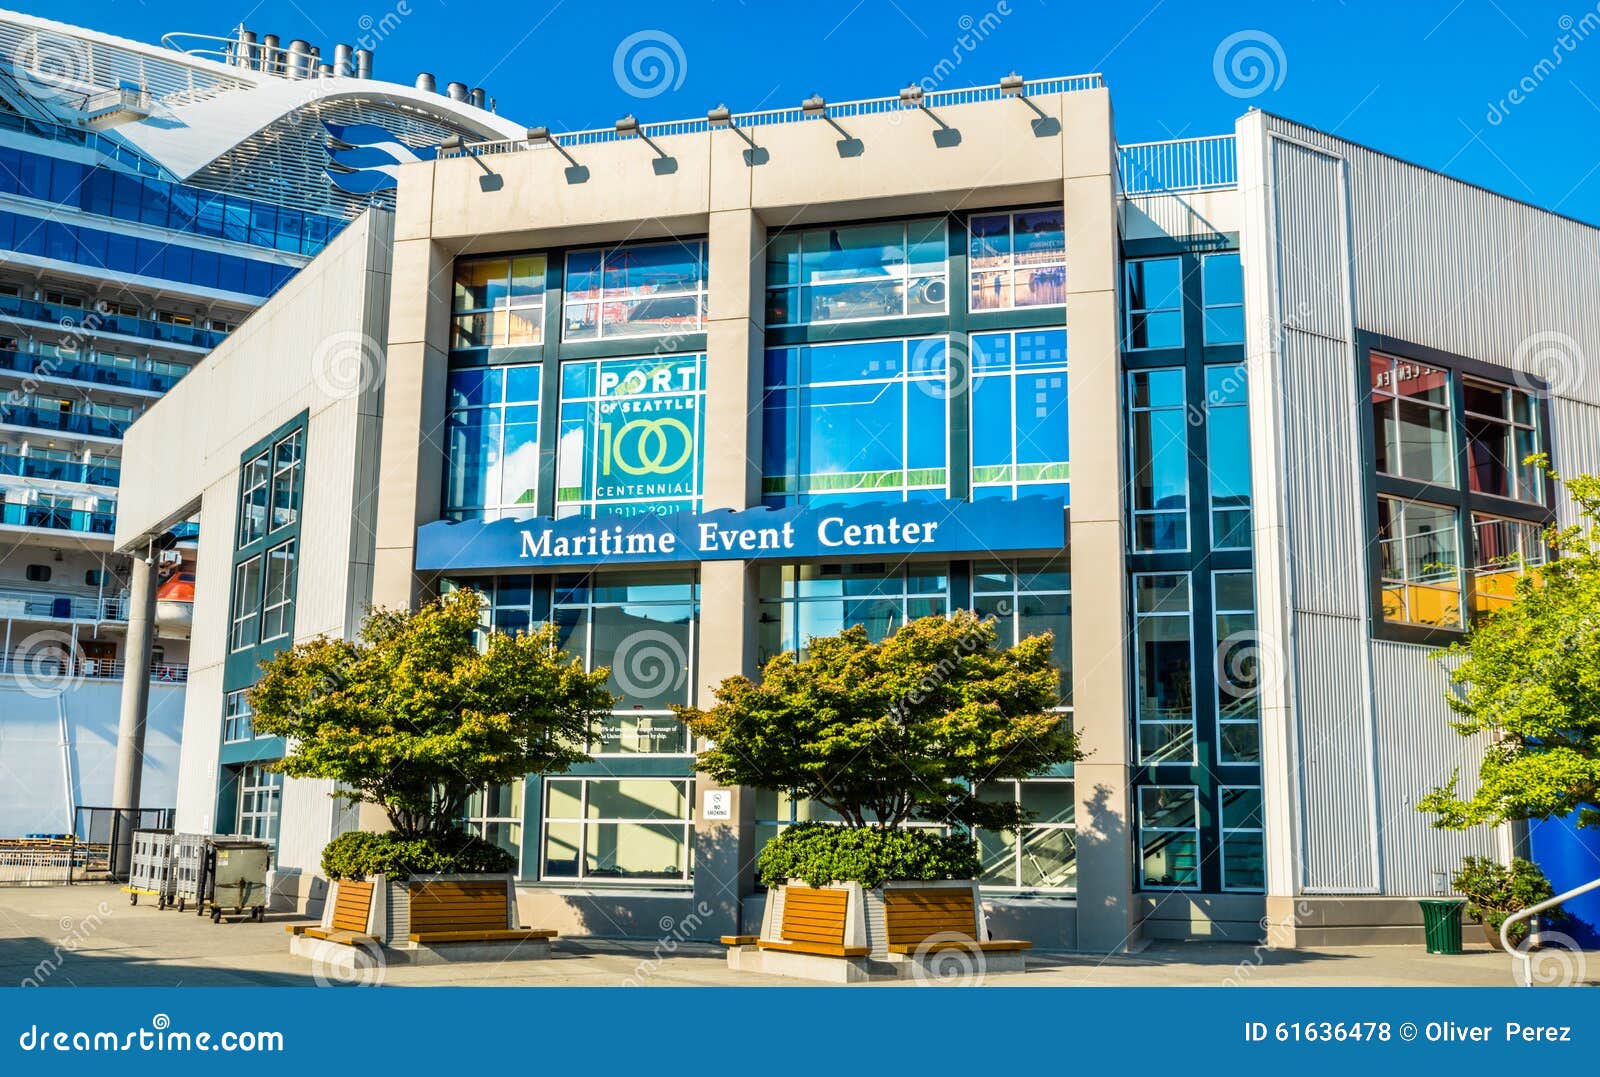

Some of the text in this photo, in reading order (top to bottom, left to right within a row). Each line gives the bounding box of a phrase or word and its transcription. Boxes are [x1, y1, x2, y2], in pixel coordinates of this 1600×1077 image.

[601, 366, 696, 396] PORT
[601, 397, 695, 414] OF SEATTLE
[600, 417, 693, 476] 100
[596, 482, 693, 497] CENTENNIAL
[519, 516, 939, 558] Maritime Event Center
